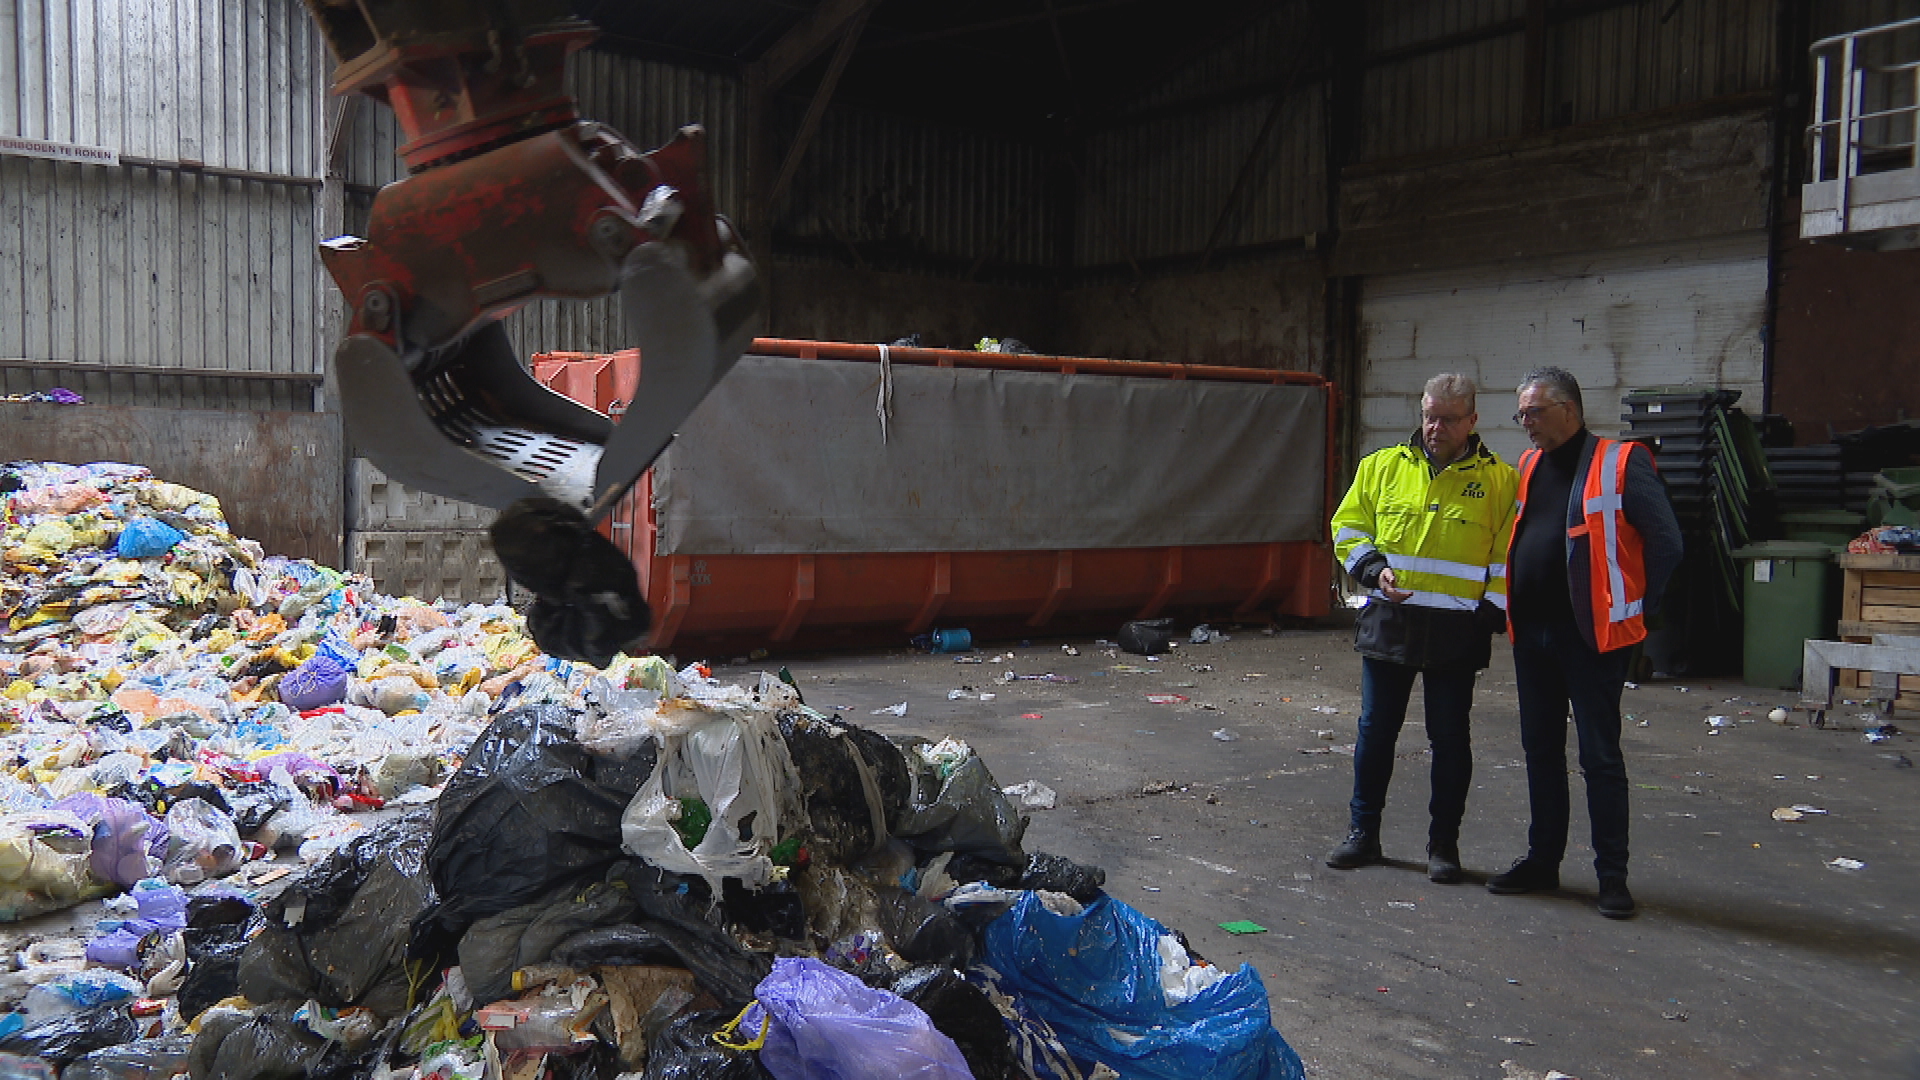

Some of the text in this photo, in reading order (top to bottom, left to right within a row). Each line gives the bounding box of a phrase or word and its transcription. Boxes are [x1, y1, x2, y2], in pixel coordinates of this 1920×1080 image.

[59, 146, 71, 156] TE
[75, 147, 111, 160] ROKEN
[1461, 488, 1485, 499] ZRD
